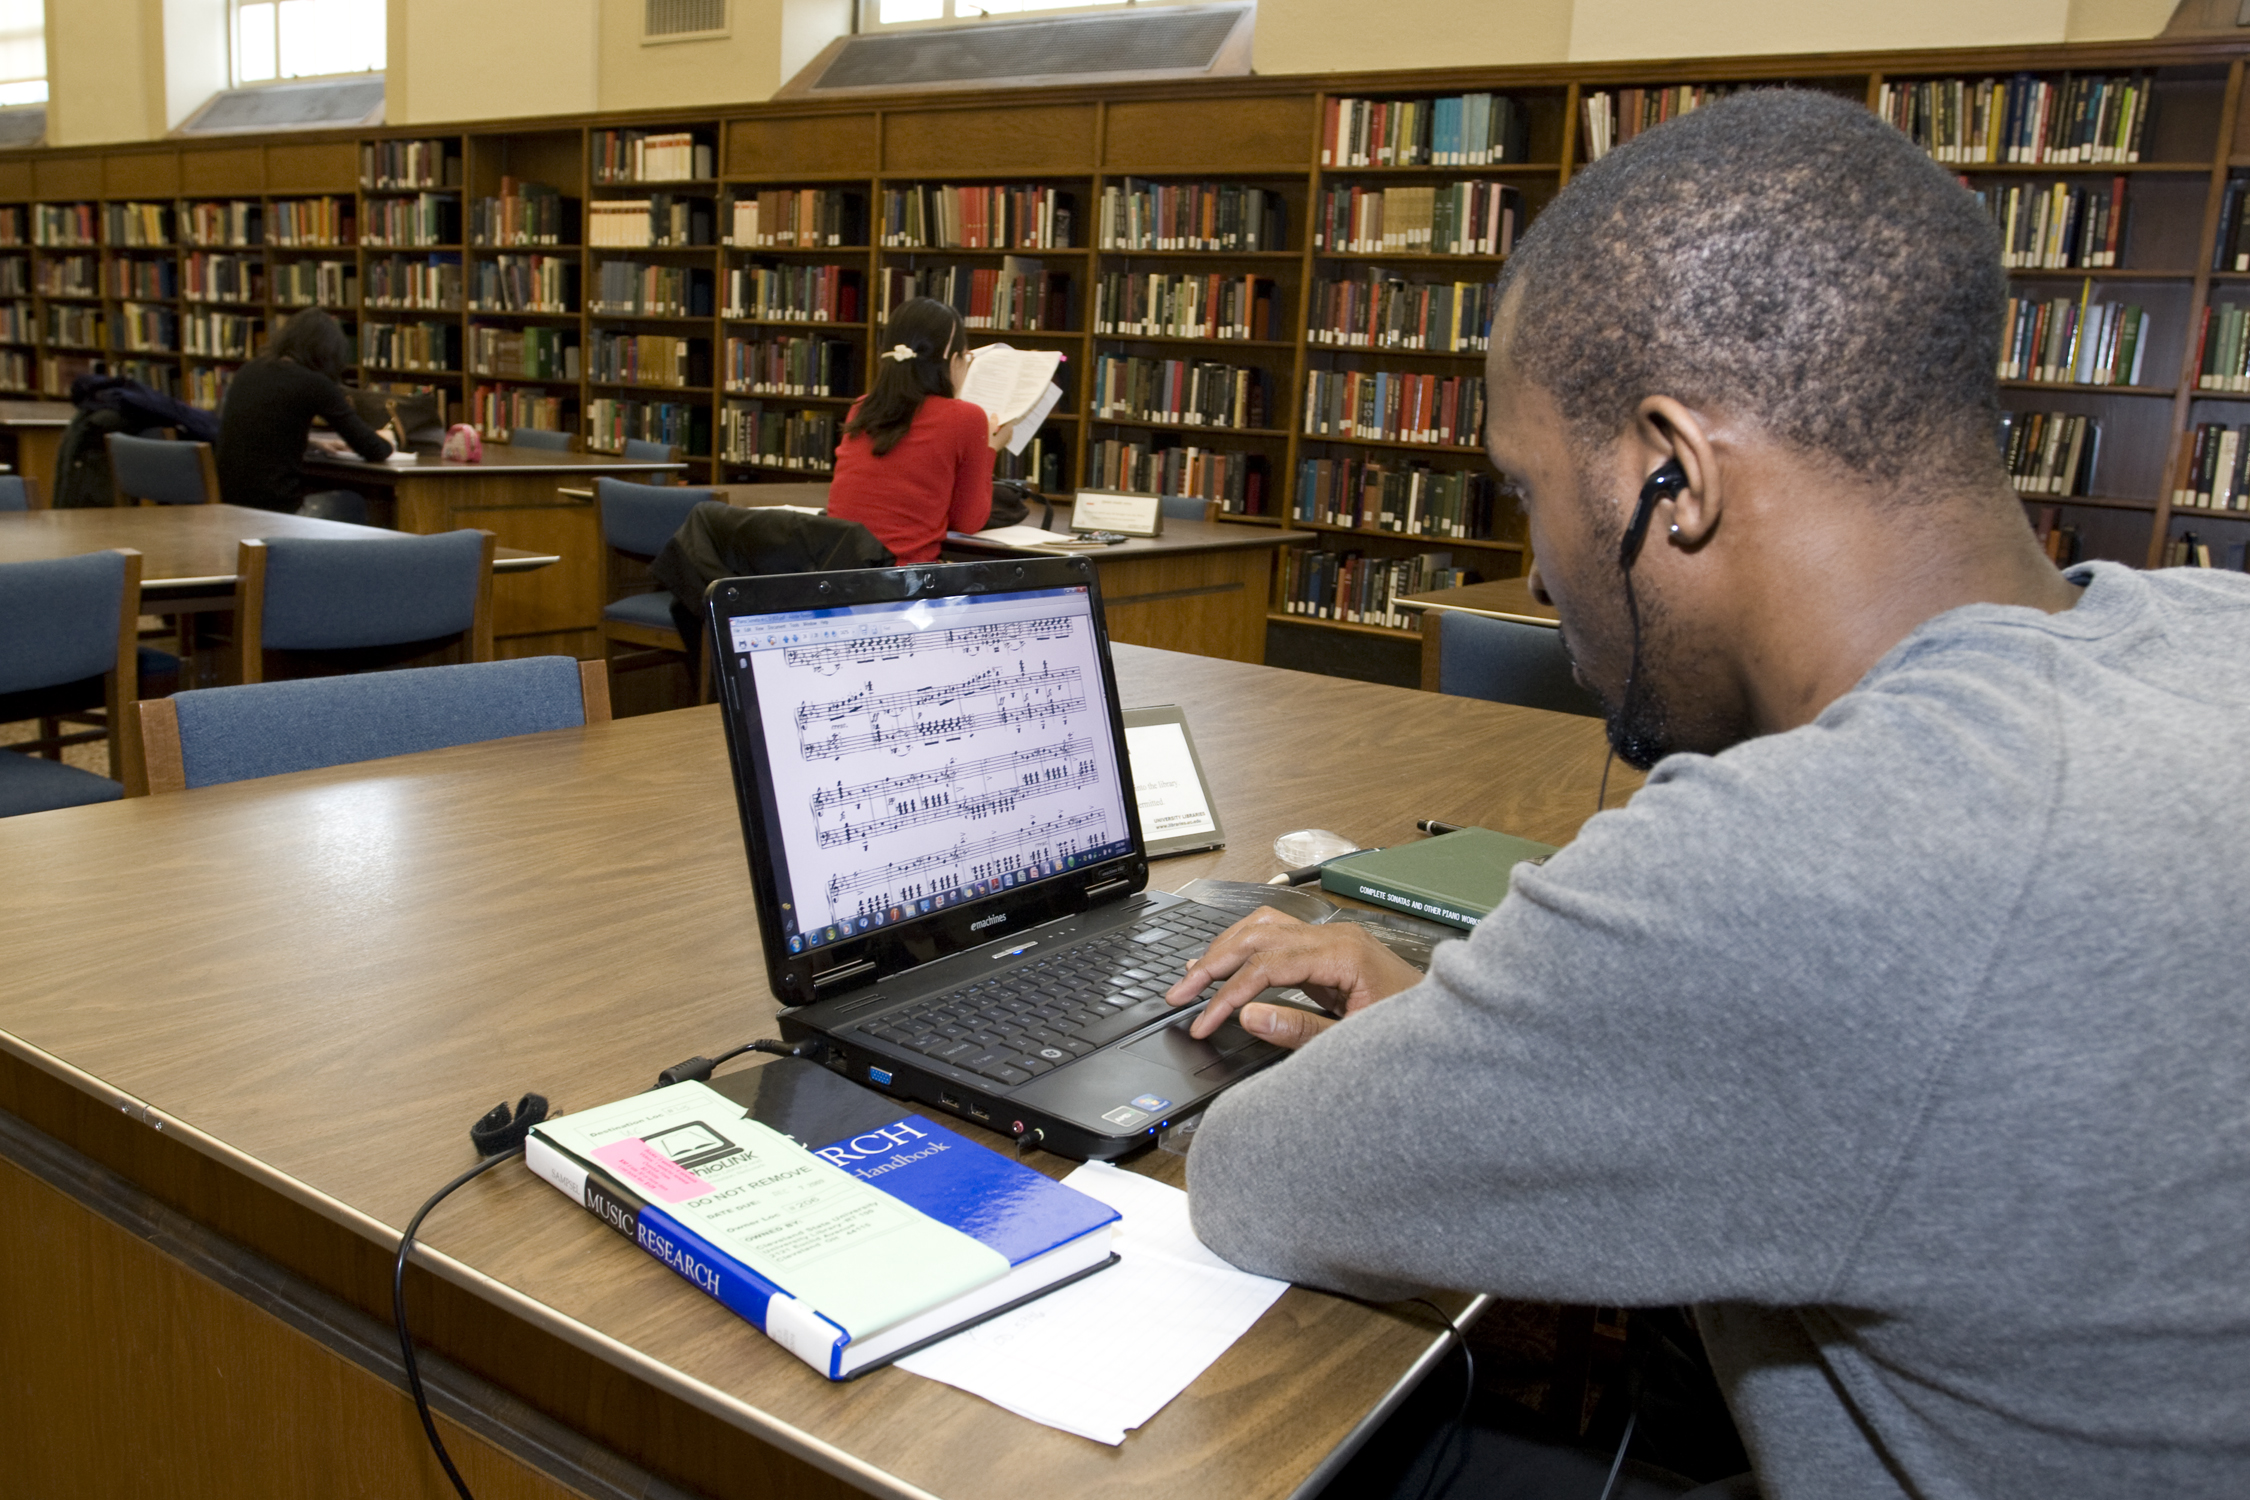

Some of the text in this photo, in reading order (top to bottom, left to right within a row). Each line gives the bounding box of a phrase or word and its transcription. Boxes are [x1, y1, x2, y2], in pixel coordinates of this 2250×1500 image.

[1138, 798, 1165, 809] ermitted.
[1153, 811, 1206, 824] UNIVERSITY LIBRARIES
[1359, 885, 1386, 900] COMPLETE
[1387, 893, 1411, 907] SONATAS
[1411, 901, 1423, 911] AND
[1423, 905, 1442, 916] OTHER
[1442, 909, 1460, 921] PIANO
[970, 913, 1007, 931] emachines
[589, 1112, 665, 1137] Destination Loc
[814, 1122, 928, 1167] RCH
[689, 1150, 760, 1178] hioLINK
[852, 1142, 952, 1182] Handbook
[551, 1168, 581, 1196] SAMPSEL
[687, 1196, 712, 1209] DO
[714, 1184, 747, 1201] NOT
[748, 1165, 813, 1190] REMOVE
[706, 1208, 735, 1220] DATE
[736, 1199, 761, 1211] DUE:
[726, 1219, 760, 1233] Owner
[761, 1212, 781, 1222] Loc
[744, 1219, 804, 1242] OWNED BY:
[756, 1200, 878, 1250] Cleveland State University
[793, 1239, 823, 1250] Euclid
[823, 1223, 856, 1240] Avenue
[587, 1188, 720, 1296] MUSIC RESEARCH
[763, 1235, 808, 1255] University
[809, 1223, 842, 1237] Library
[776, 1243, 821, 1263] Cleveland
